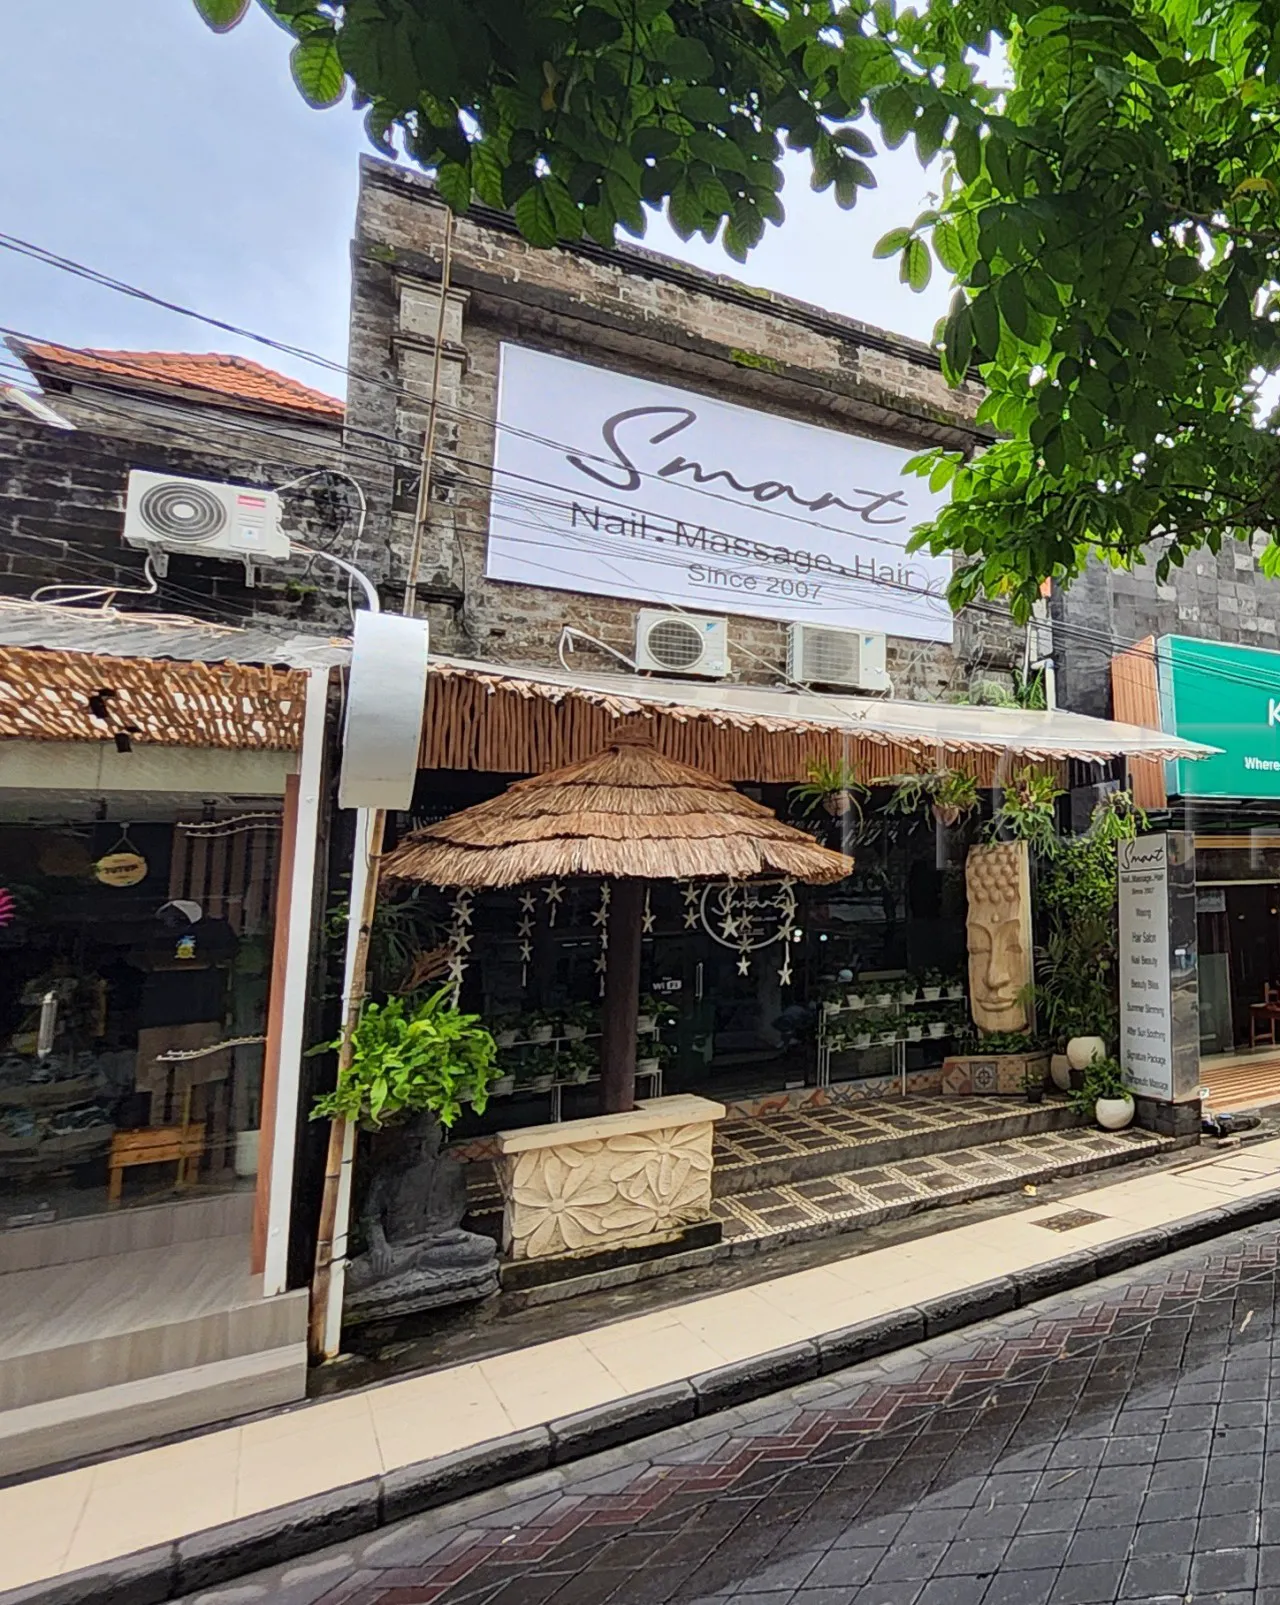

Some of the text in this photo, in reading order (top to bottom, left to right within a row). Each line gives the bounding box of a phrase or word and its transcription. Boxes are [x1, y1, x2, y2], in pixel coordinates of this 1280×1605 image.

[566, 406, 907, 525] Smart
[688, 563, 823, 600] Since 2007
[855, 555, 915, 588] Hair
[1244, 757, 1280, 771] Where
[1121, 840, 1164, 870] Smart
